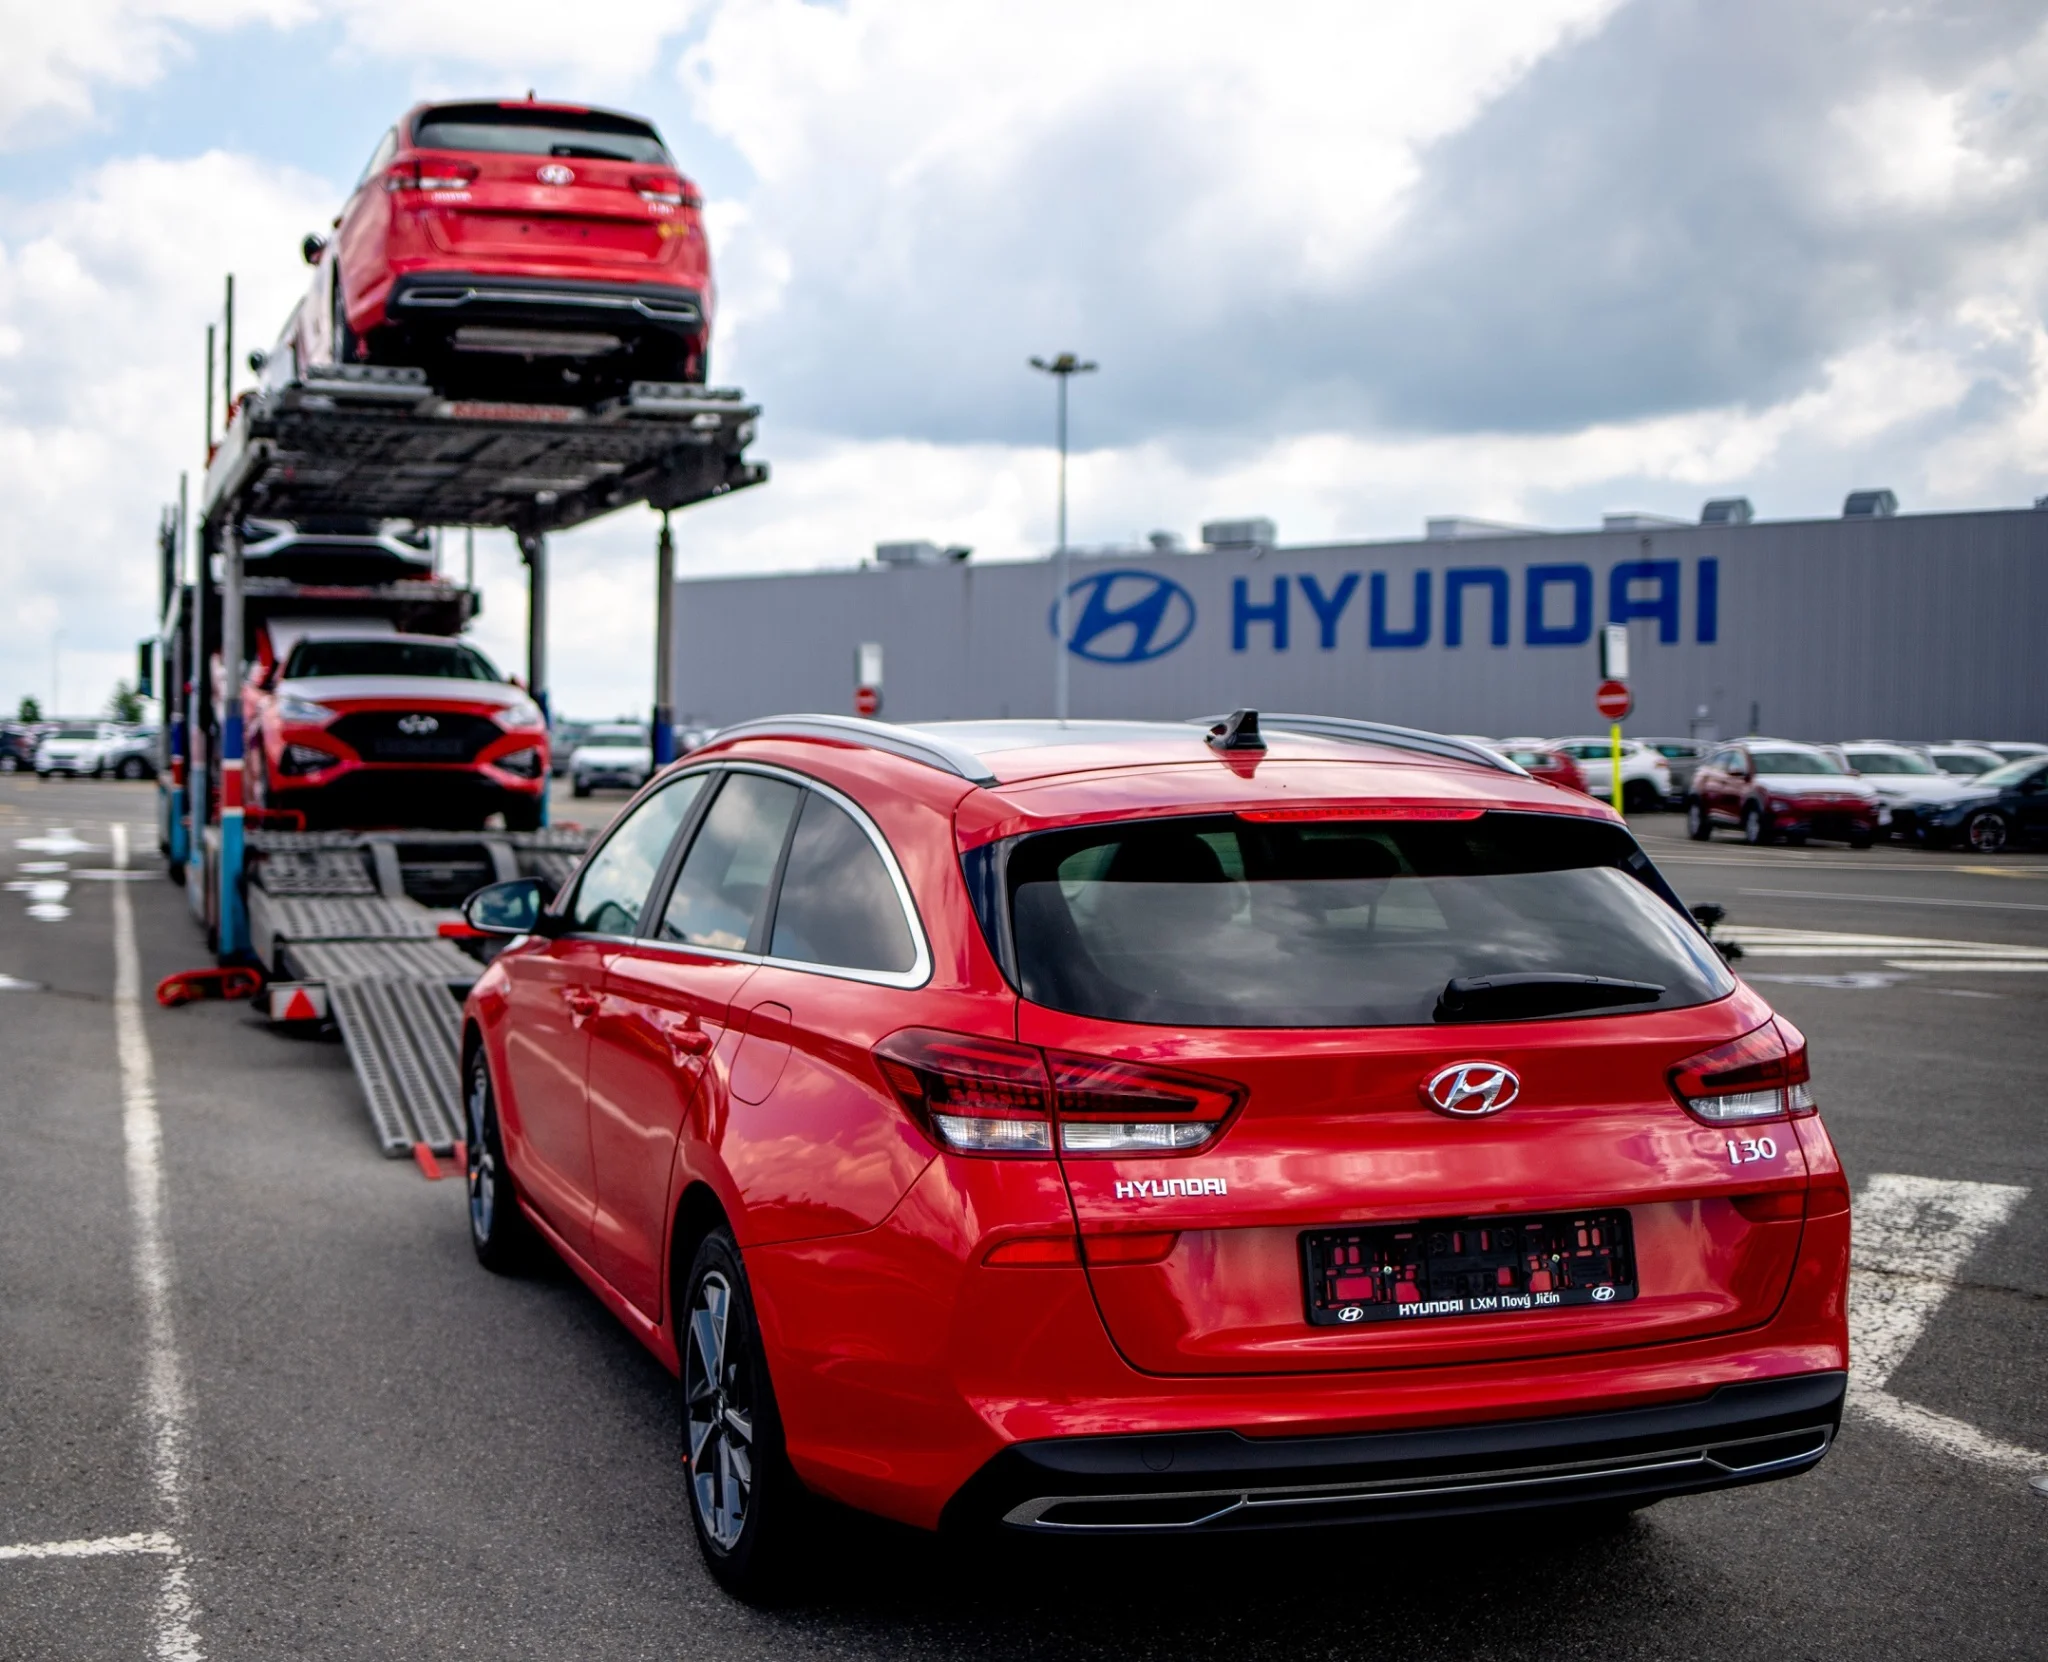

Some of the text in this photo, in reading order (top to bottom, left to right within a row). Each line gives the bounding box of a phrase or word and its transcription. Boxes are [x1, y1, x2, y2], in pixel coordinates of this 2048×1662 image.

[1231, 557, 1719, 652] HYUNDAI
[1115, 1177, 1228, 1199] HYUNDAI
[1399, 1300, 1464, 1316] HYUNDAI
[1470, 1297, 1498, 1311] LXM
